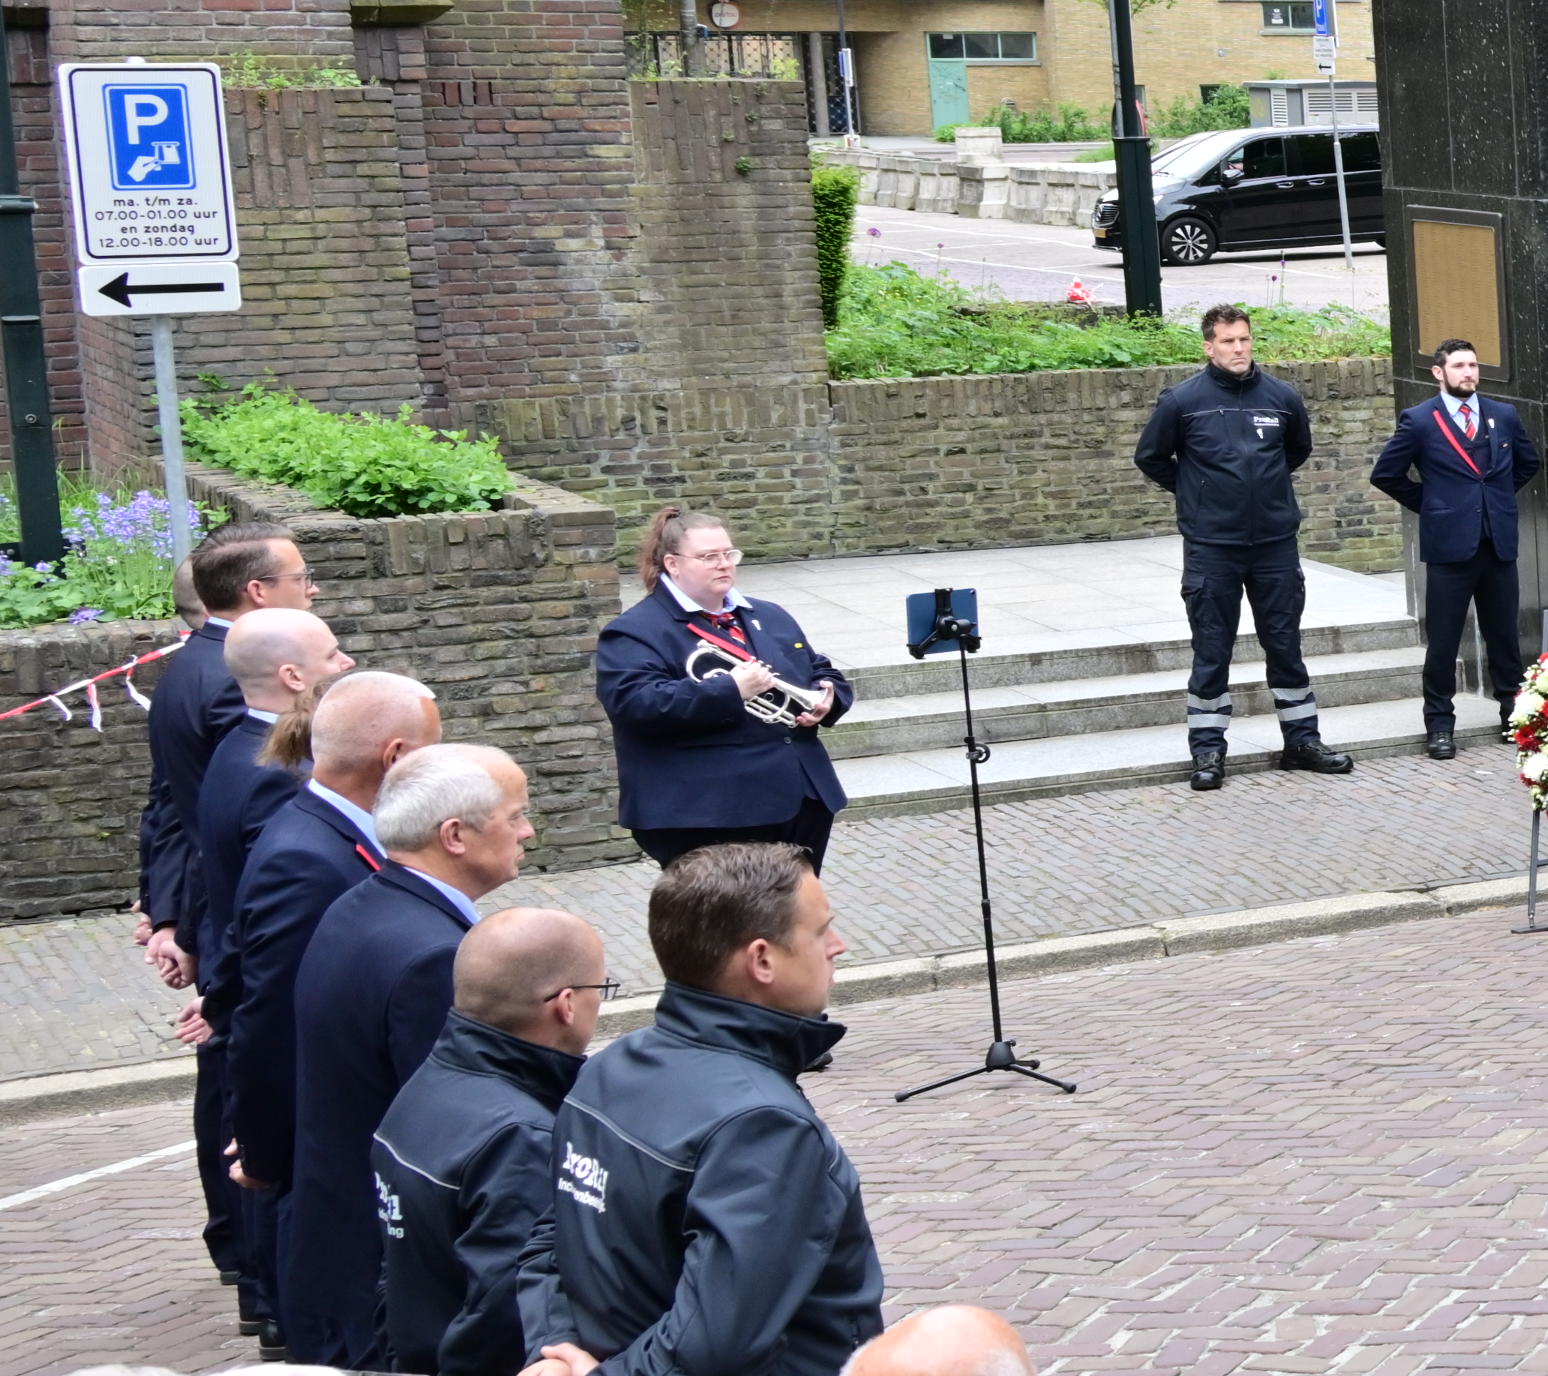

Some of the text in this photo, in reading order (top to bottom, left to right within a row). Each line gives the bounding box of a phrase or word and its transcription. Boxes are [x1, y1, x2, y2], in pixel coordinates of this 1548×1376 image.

[123, 94, 169, 144] P
[114, 196, 198, 207] ma. t/m za.
[95, 209, 218, 221] 07.00-01.00 uur
[121, 224, 195, 235] en zondag
[100, 236, 219, 248] 12.00-18.00 uur
